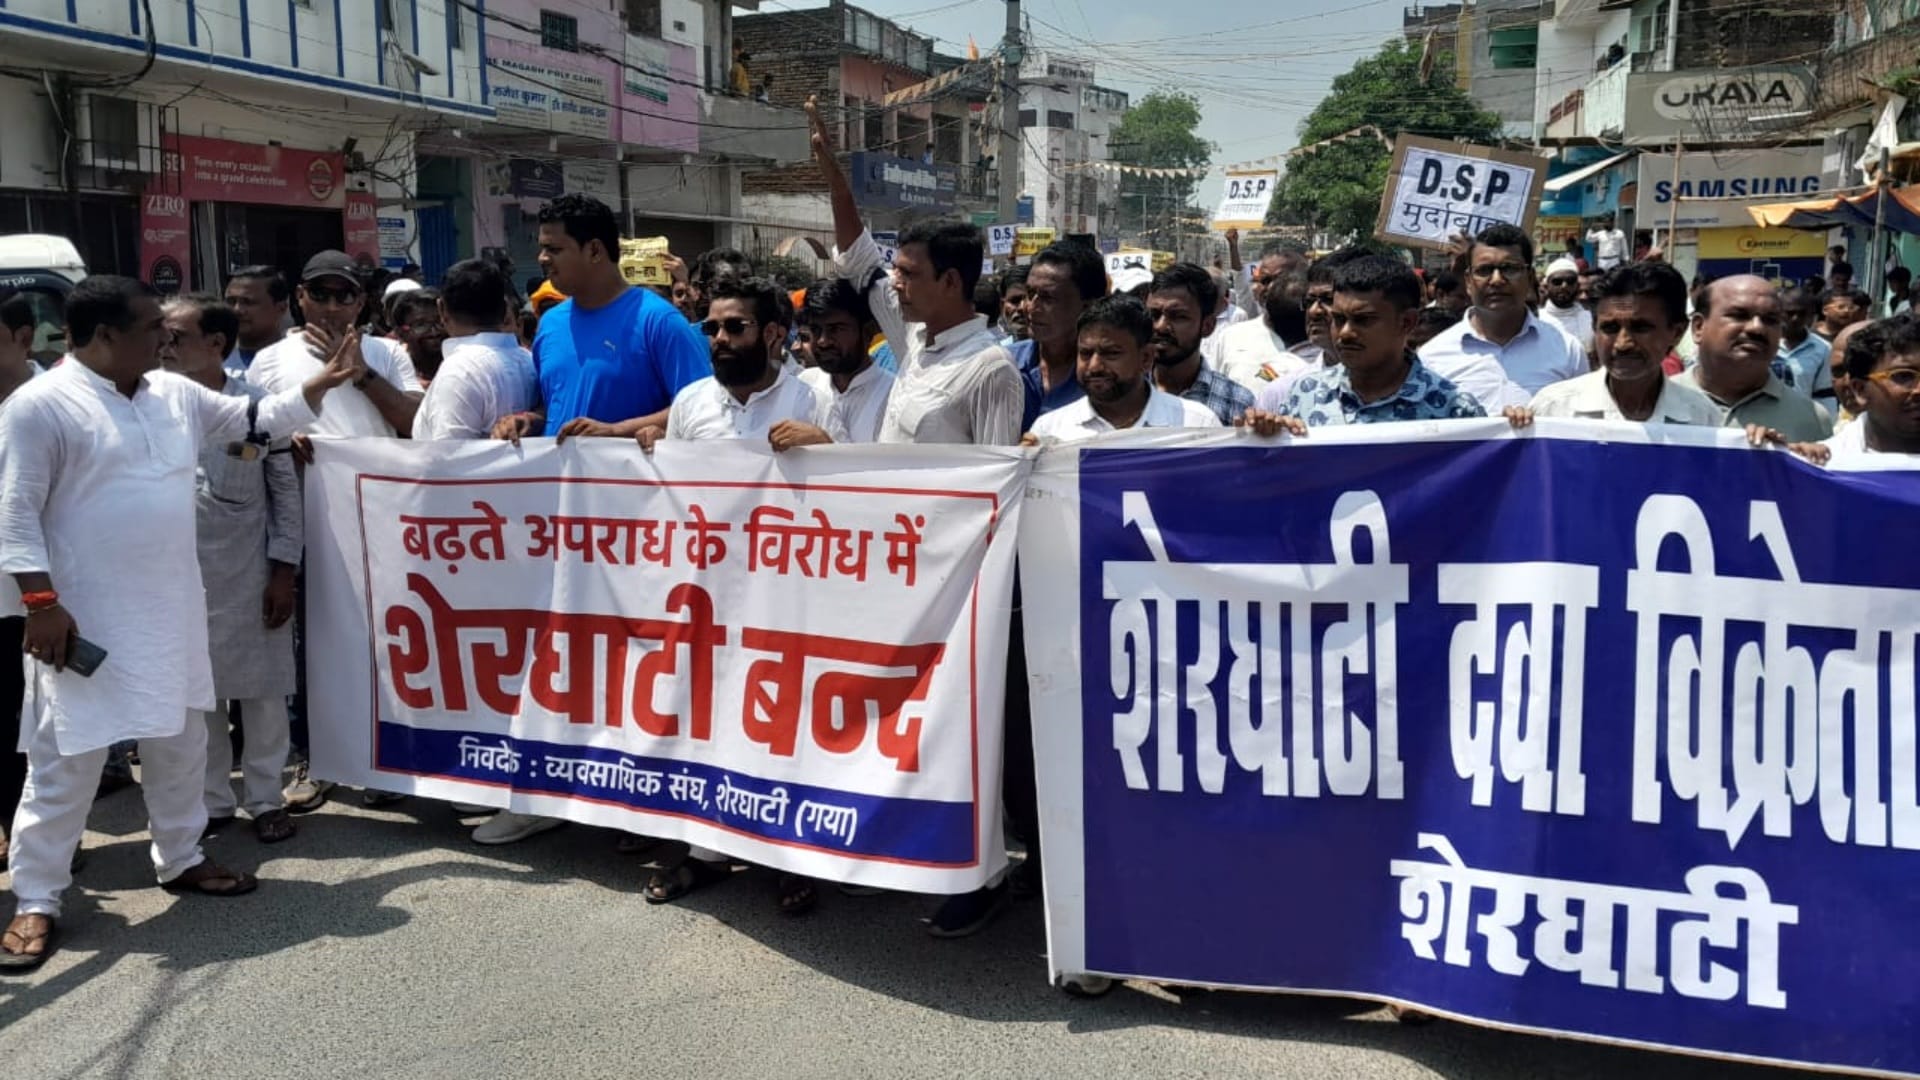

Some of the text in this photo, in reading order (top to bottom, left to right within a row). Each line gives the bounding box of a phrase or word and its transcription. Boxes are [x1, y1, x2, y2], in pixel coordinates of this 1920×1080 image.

[1229, 178, 1267, 200] D.S.P
[1417, 158, 1510, 206] D.S.P
[1654, 176, 1820, 203] SAMSUNG
[400, 501, 927, 587] बढ़ते अपराध के विरोध में
[385, 573, 948, 773] शेरघाटी बन्द
[1103, 490, 1920, 851] शेरघाटी दवा विक्रेता
[545, 757, 664, 797] व्यवसायिक
[668, 767, 708, 811] संघ,
[715, 774, 791, 826] शेरघाटी
[794, 799, 859, 847] (गया)
[1390, 832, 1799, 1010] शेरघाटी
